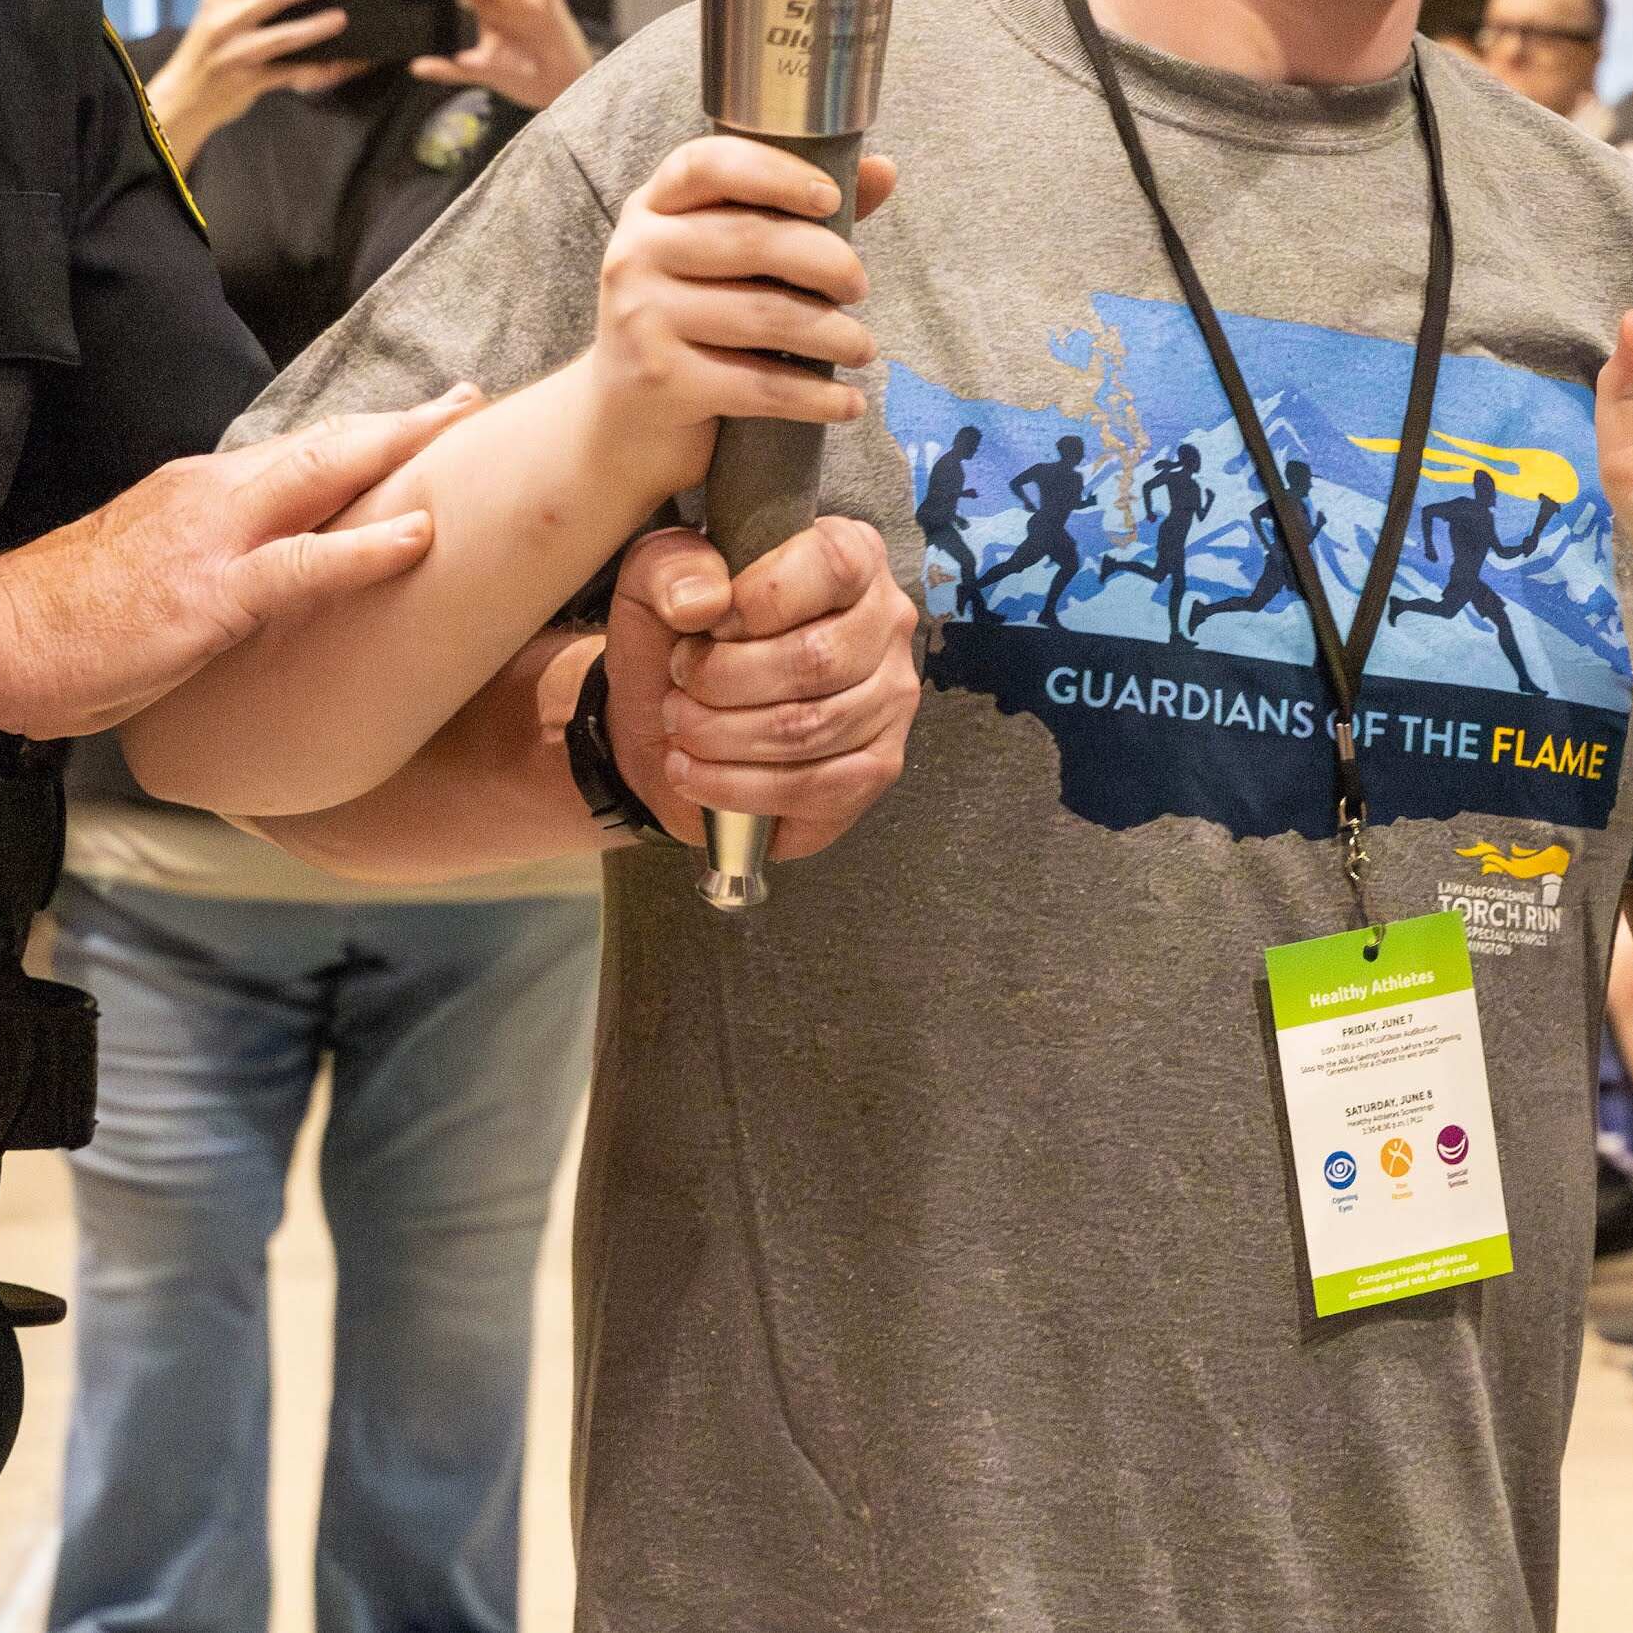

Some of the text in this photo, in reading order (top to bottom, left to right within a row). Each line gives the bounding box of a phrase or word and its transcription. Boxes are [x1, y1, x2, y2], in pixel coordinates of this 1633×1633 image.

[1045, 666, 1609, 781] GUARDIANS OF THE FLAME
[1438, 880, 1463, 896] LAW
[1437, 894, 1562, 933] TORCH RUN
[1310, 970, 1436, 1009] Healthy Athletes
[1341, 1013, 1414, 1038] FRIDAY, JUNE 7
[1344, 1097, 1398, 1118] SATURDAY,
[1400, 1091, 1425, 1106] JUNE
